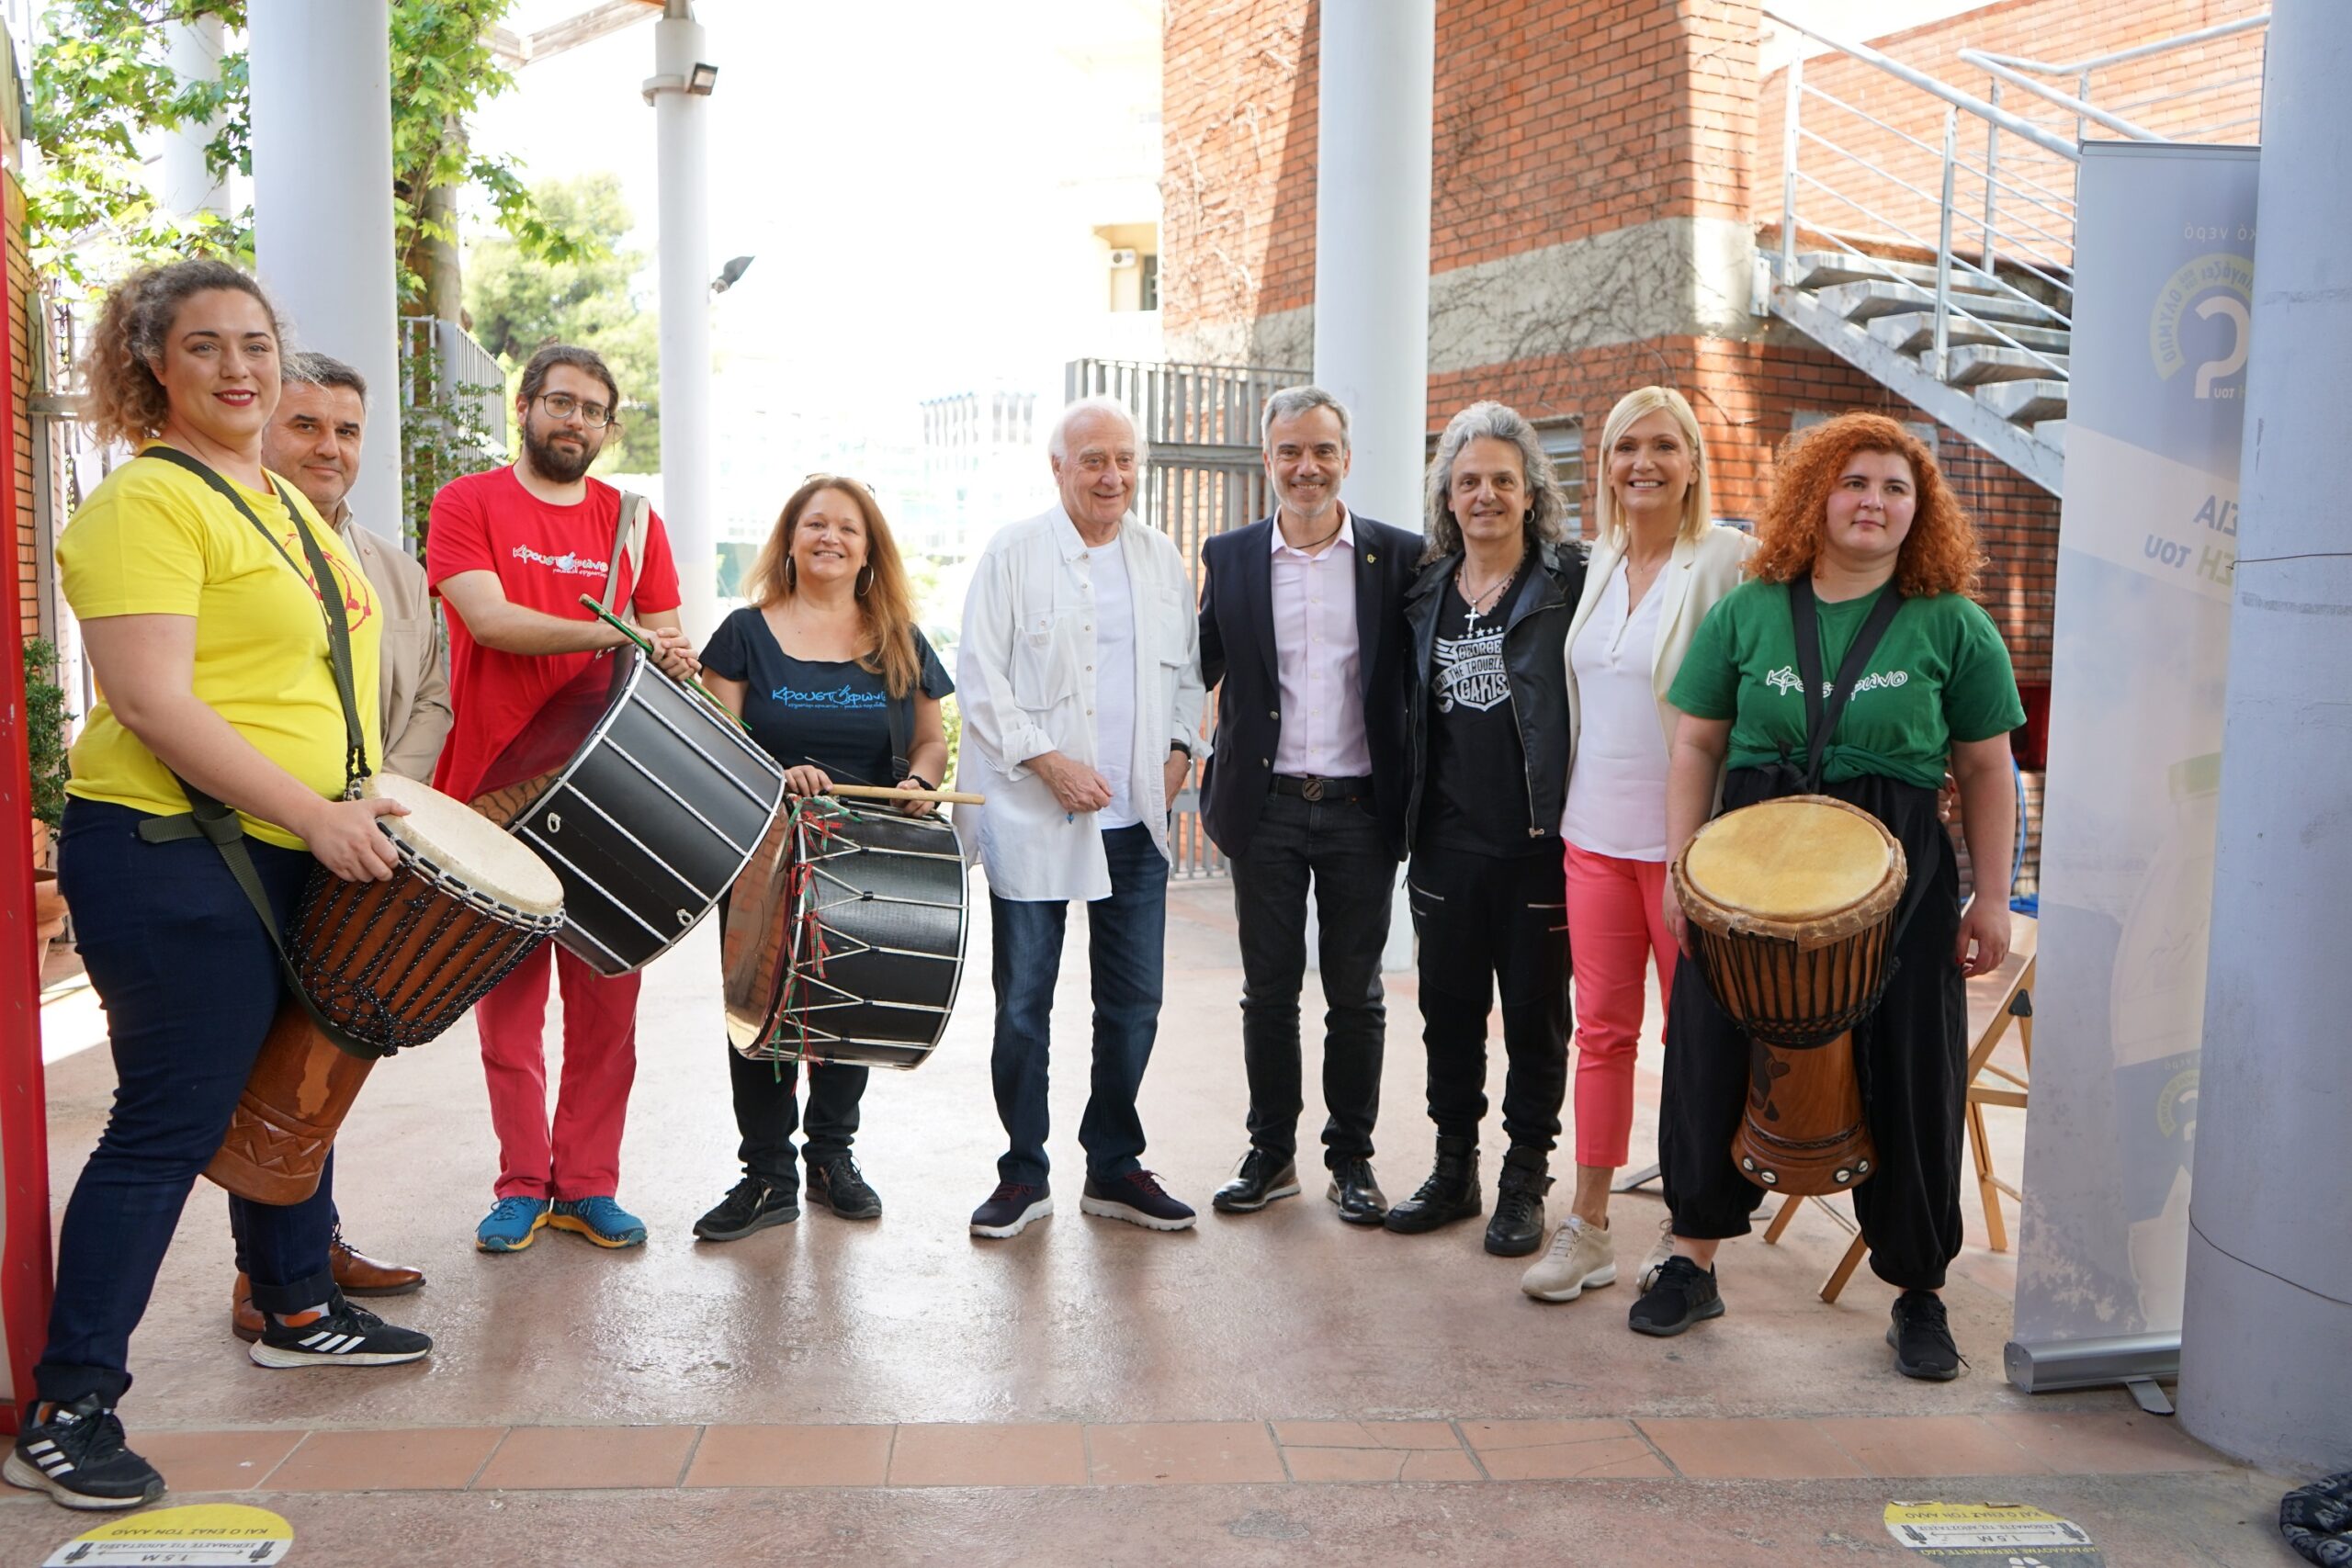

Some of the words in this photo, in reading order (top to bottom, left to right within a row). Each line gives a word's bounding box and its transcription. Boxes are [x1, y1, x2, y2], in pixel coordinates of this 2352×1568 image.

[1458, 639, 1502, 660] GEORGE
[1448, 664, 1464, 680] THE
[1460, 673, 1508, 703] GAKIS
